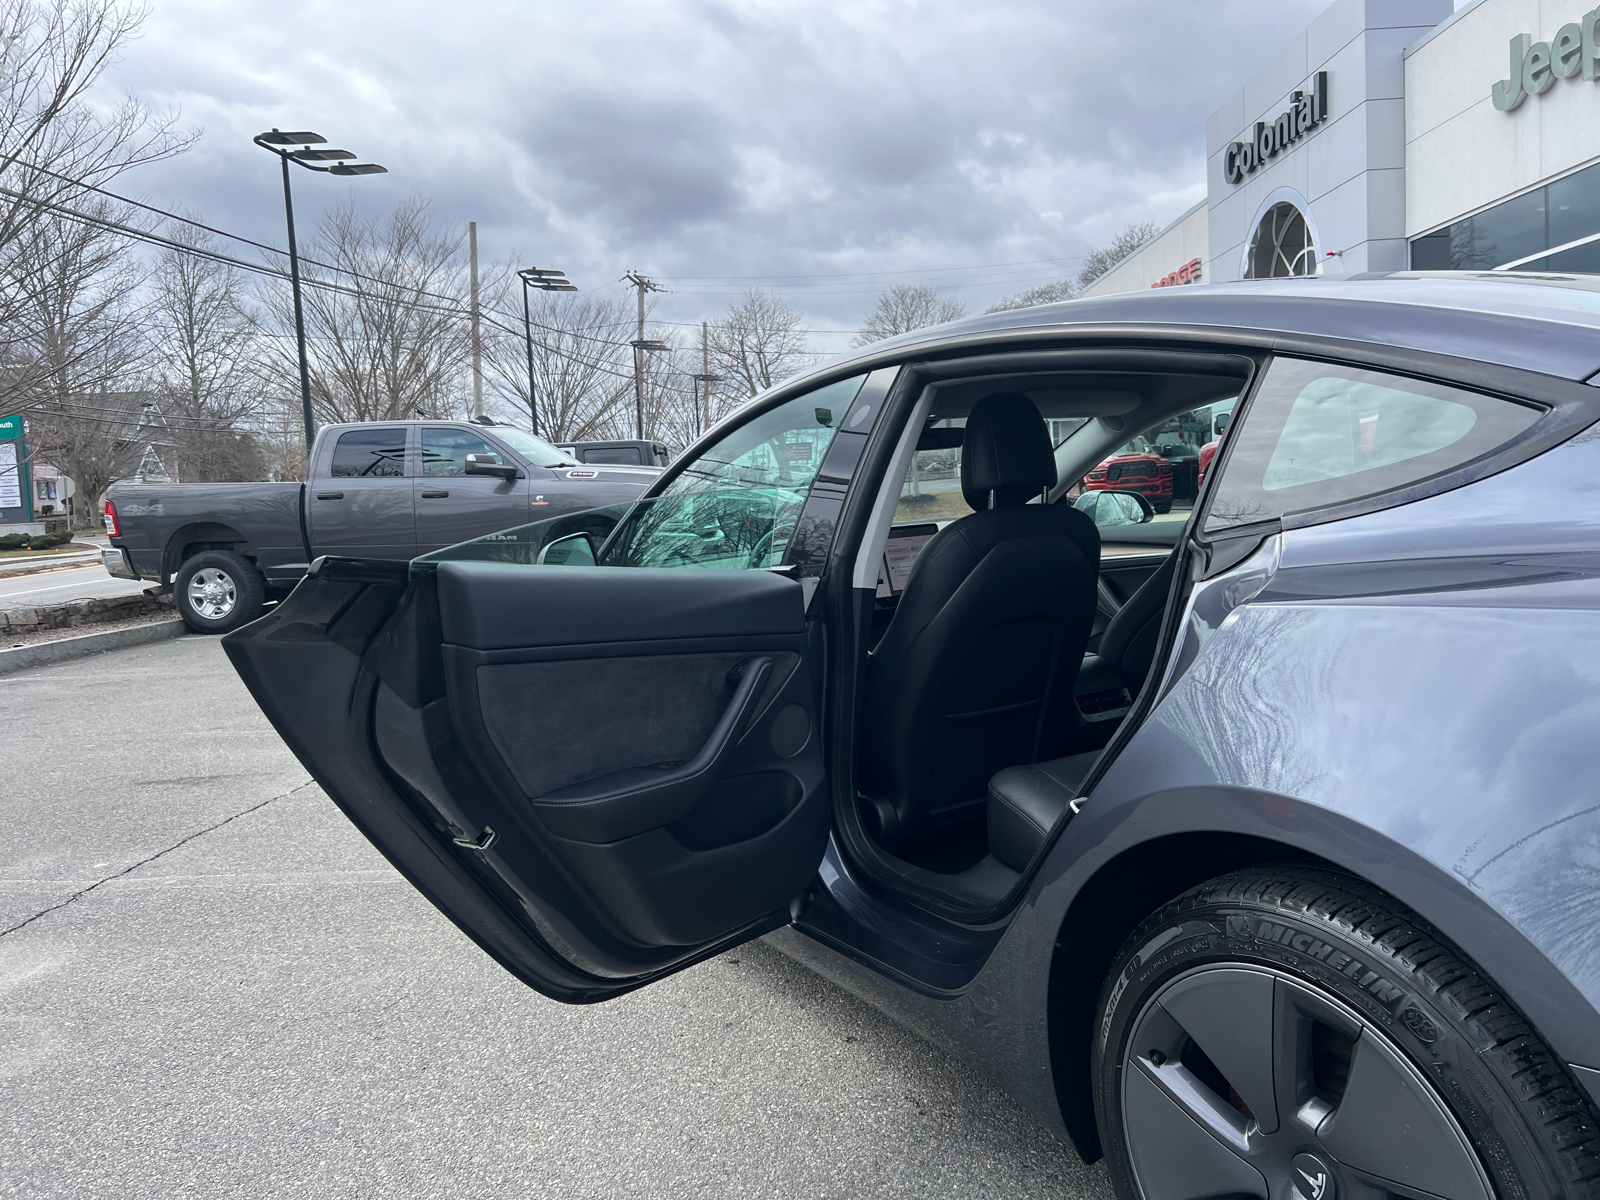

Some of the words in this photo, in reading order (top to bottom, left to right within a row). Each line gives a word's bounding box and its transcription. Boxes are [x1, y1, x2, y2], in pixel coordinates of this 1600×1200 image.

[1492, 4, 1600, 112] Jeep
[1223, 71, 1328, 185] Colonial
[1151, 258, 1202, 288] ODGE
[1256, 922, 1403, 1004] MICHELIN
